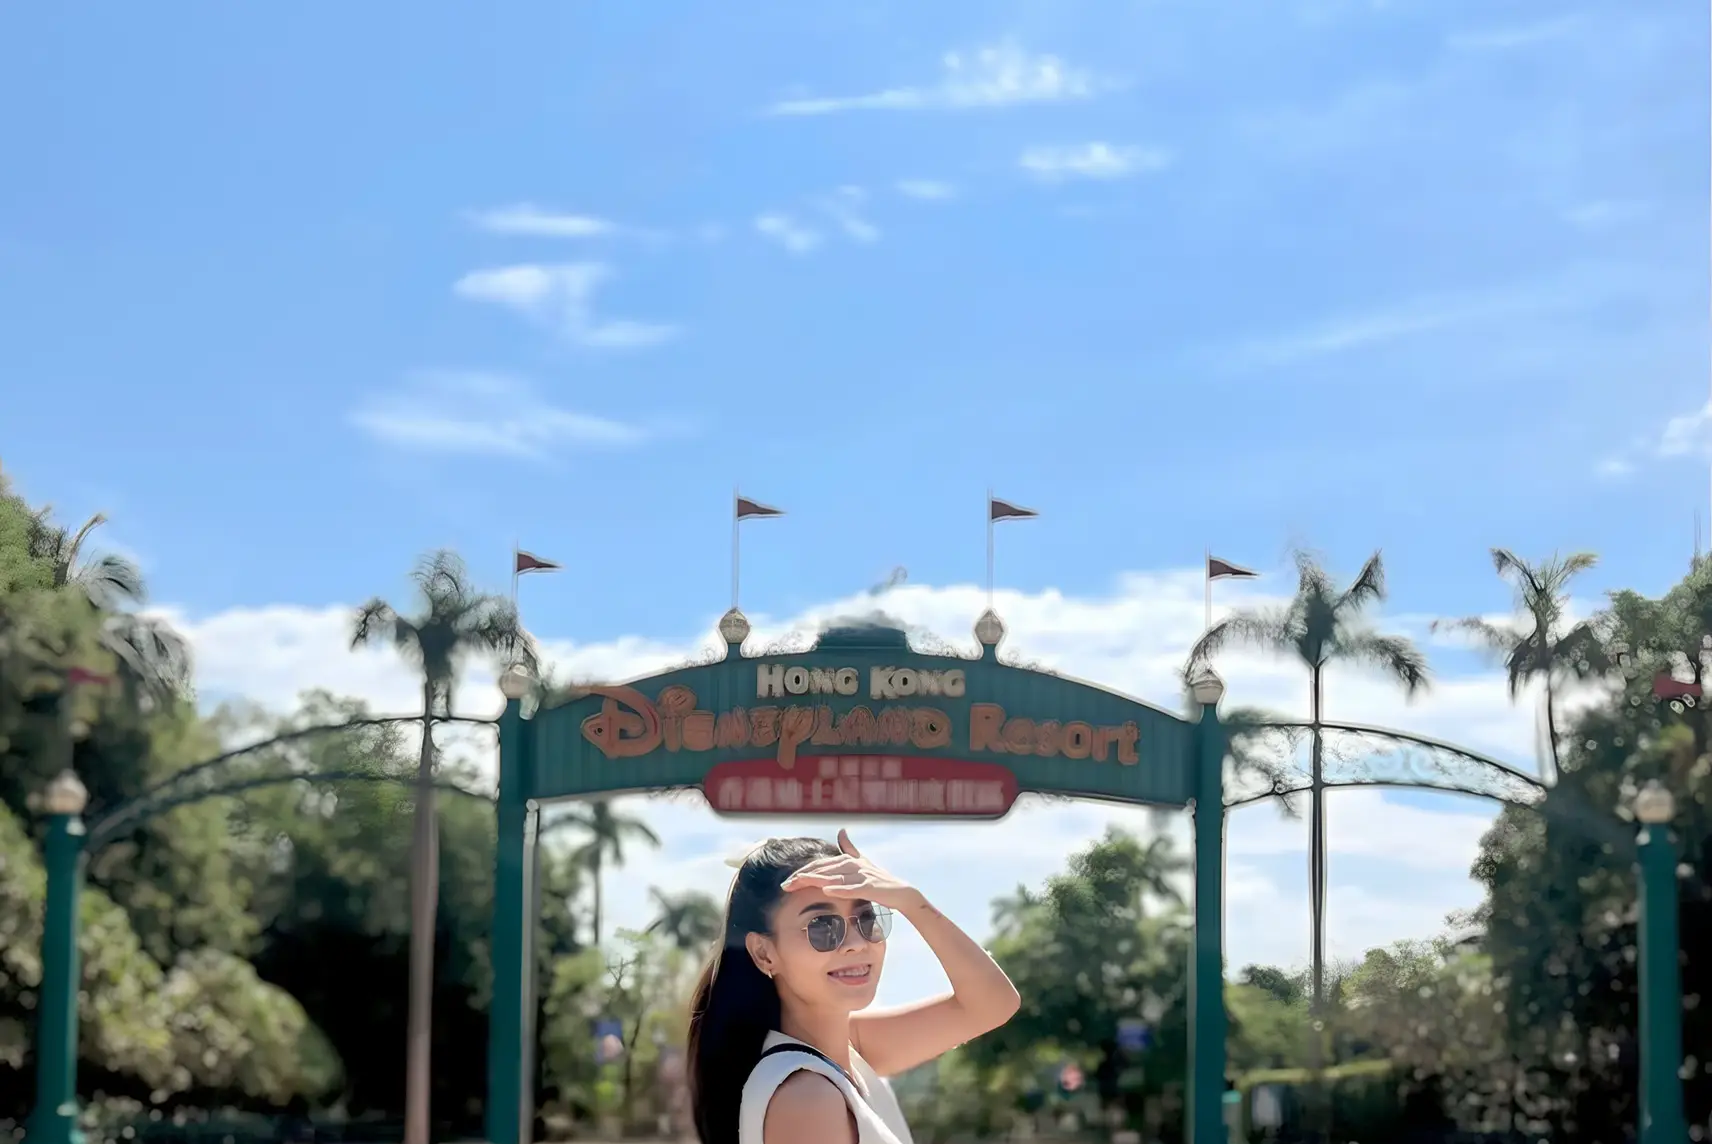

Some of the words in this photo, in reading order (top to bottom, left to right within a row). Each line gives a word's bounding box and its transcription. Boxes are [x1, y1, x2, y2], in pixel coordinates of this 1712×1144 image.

[756, 664, 859, 698] HONG
[870, 665, 966, 699] KONG
[969, 703, 1140, 766] Resort
